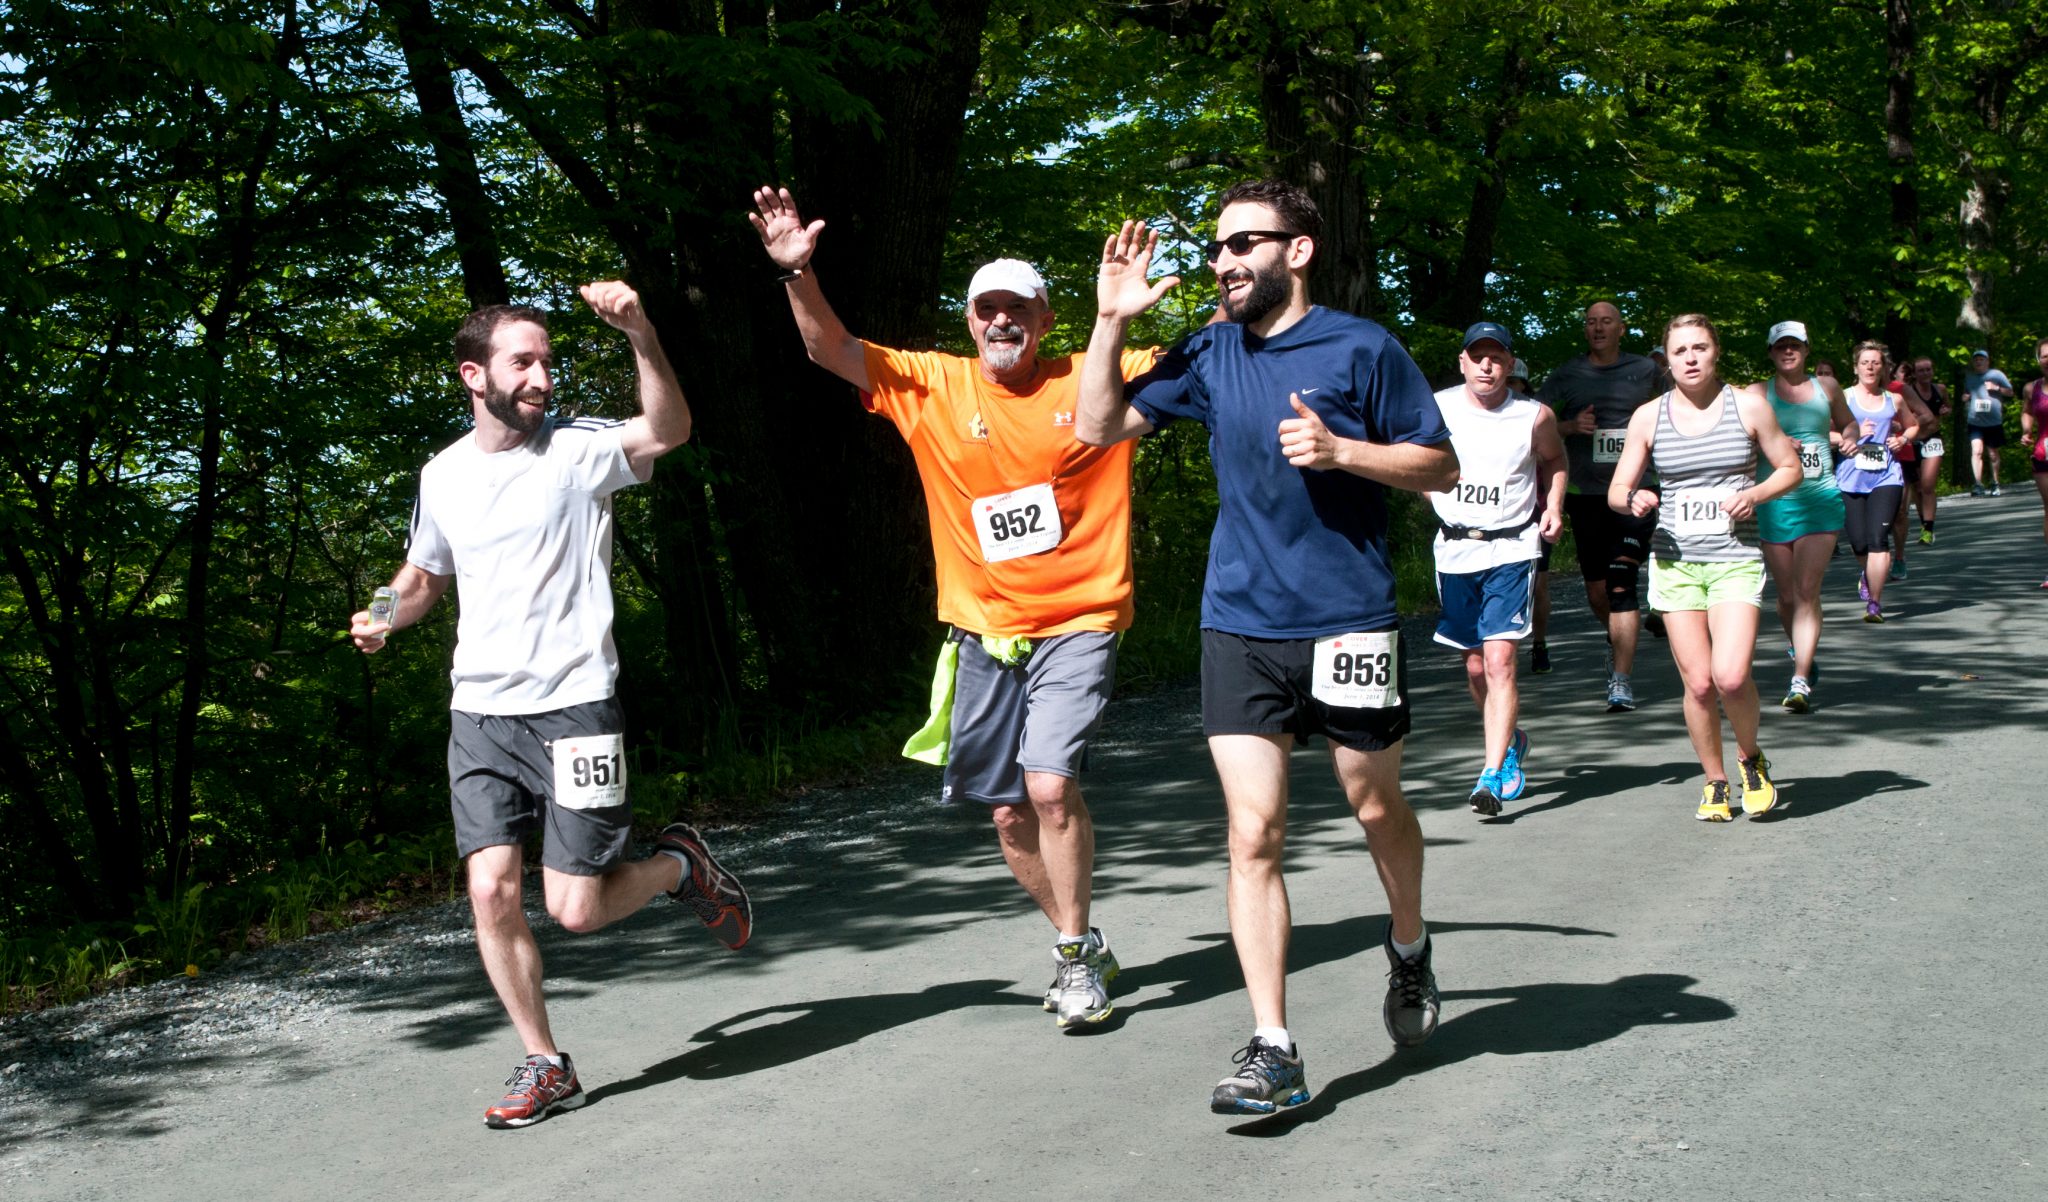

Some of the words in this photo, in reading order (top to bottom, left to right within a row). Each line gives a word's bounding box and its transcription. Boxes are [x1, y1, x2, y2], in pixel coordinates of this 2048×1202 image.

[1800, 453, 1820, 468] 39
[1456, 484, 1500, 506] 1204
[989, 504, 1046, 541] 952
[1332, 652, 1391, 687] 953
[573, 753, 620, 788] 951
